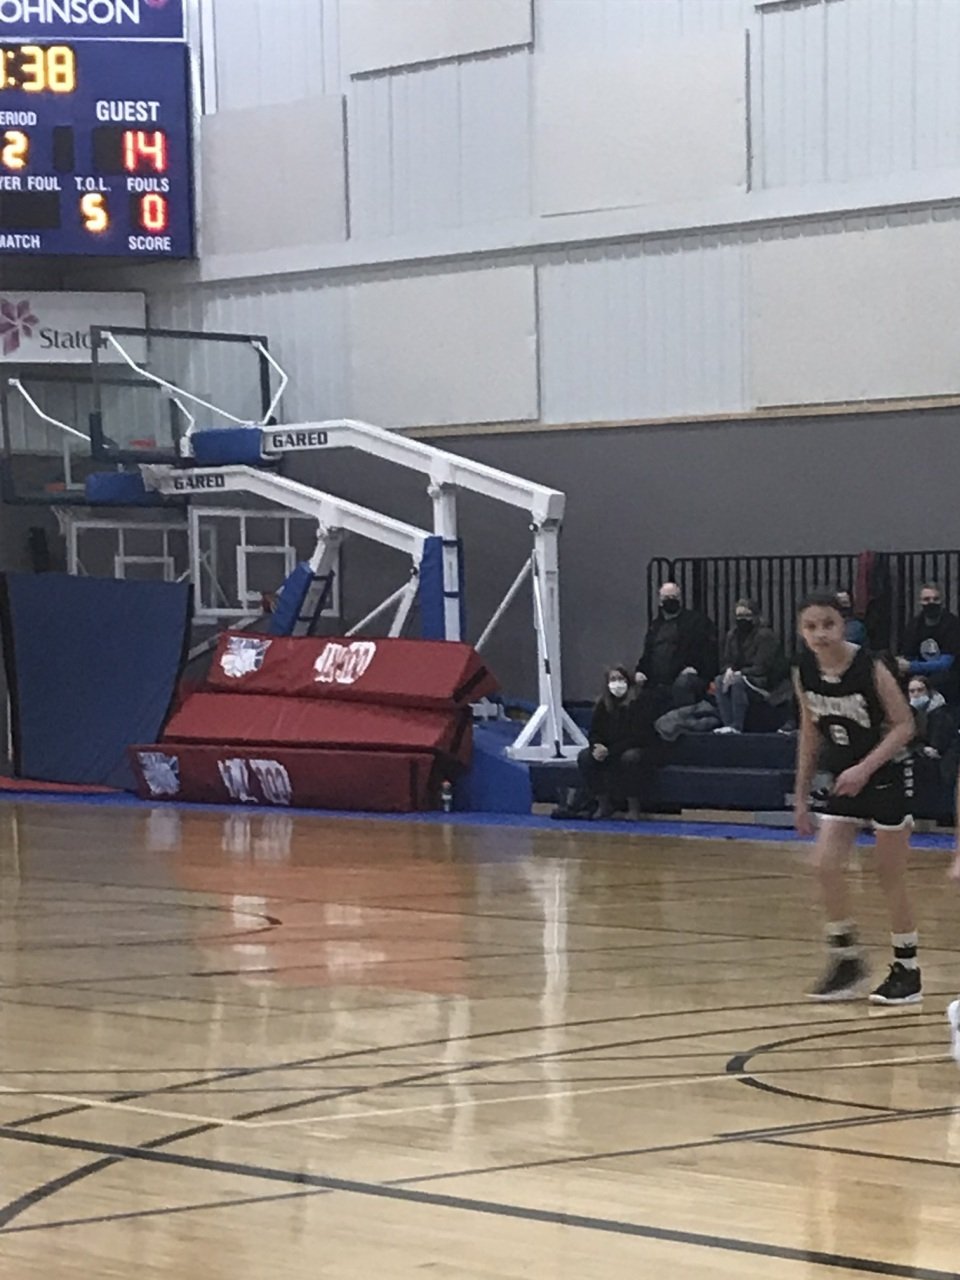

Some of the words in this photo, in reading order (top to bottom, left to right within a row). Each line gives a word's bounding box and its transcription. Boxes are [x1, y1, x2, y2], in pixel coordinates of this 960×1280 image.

[0, 0, 140, 24] OHNSON
[0, 45, 75, 93] :38
[96, 100, 161, 122] GUEST
[2, 130, 29, 170] 2
[123, 130, 167, 172] 14
[28, 176, 61, 191] FOUL
[74, 177, 112, 192] T.O.L.
[127, 177, 170, 192] FOULS
[81, 192, 109, 232] 5
[142, 193, 166, 230] 0
[128, 236, 172, 251] SCORE
[272, 431, 329, 449] GARED
[173, 473, 226, 491] GARED
